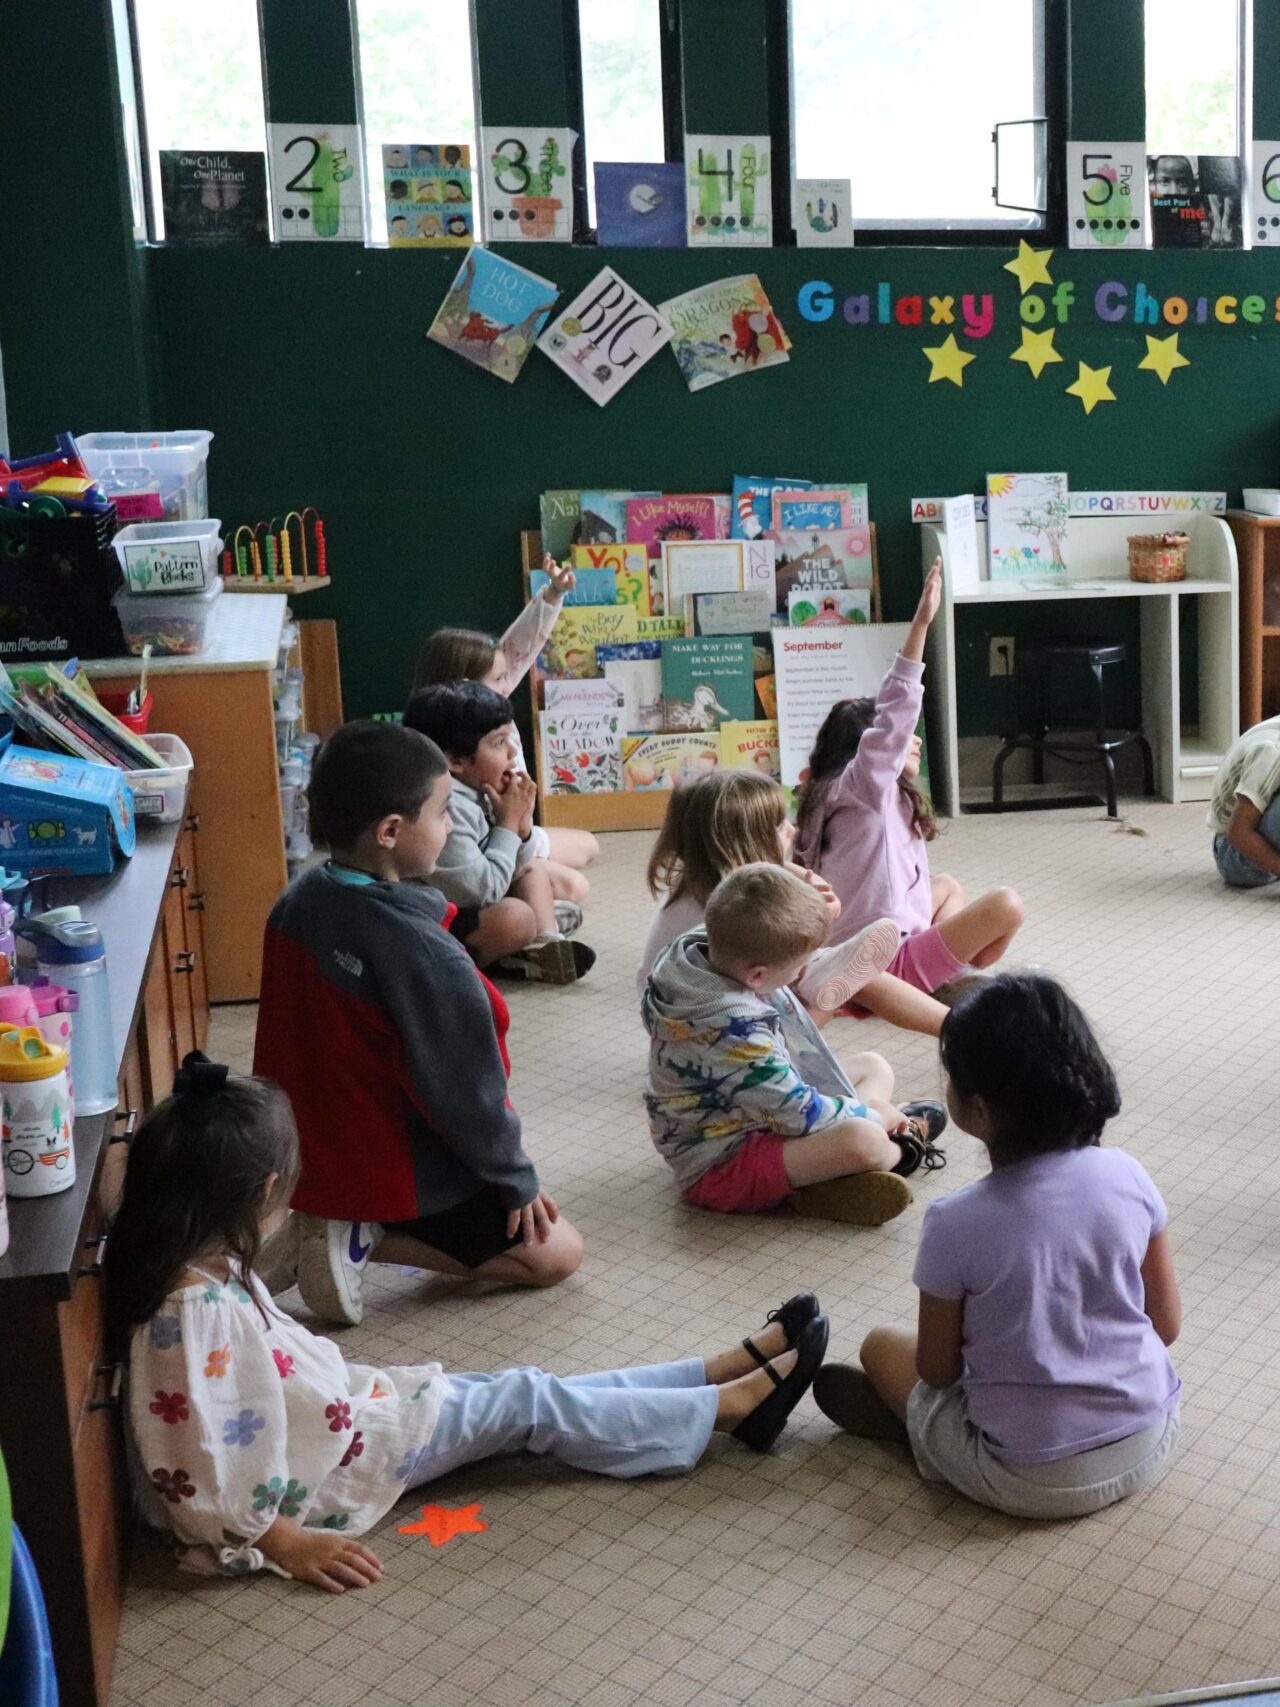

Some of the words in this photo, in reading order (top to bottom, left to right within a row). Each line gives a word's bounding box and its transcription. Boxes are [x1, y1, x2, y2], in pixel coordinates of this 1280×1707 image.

[283, 136, 323, 192] 2
[495, 138, 532, 195] 3
[210, 169, 246, 181] Planet
[698, 148, 734, 202] 4
[1082, 153, 1113, 206] 5
[1153, 198, 1171, 207] Best
[1173, 198, 1191, 207] Part
[490, 266, 530, 297] HOT
[481, 281, 521, 313] DOG
[797, 280, 994, 339] Galaxy
[1019, 281, 1075, 325] of
[576, 275, 662, 369] BIG
[748, 486, 769, 497] THE
[784, 509, 793, 522] I
[793, 503, 819, 515] LIKE
[822, 504, 840, 518] ME!
[154, 560, 198, 573] Pattern
[803, 558, 831, 569] THE
[160, 570, 195, 585] Blocks
[797, 569, 838, 584] WILD
[672, 644, 698, 653] MAKE
[702, 643, 720, 651] WAY
[723, 642, 743, 651] FOR
[783, 641, 843, 654] September
[691, 655, 744, 664] DUCKLINGS
[560, 717, 600, 732] Over
[746, 727, 768, 735] HOW
[548, 736, 614, 750] MEADOW
[737, 739, 779, 753] BUCKE
